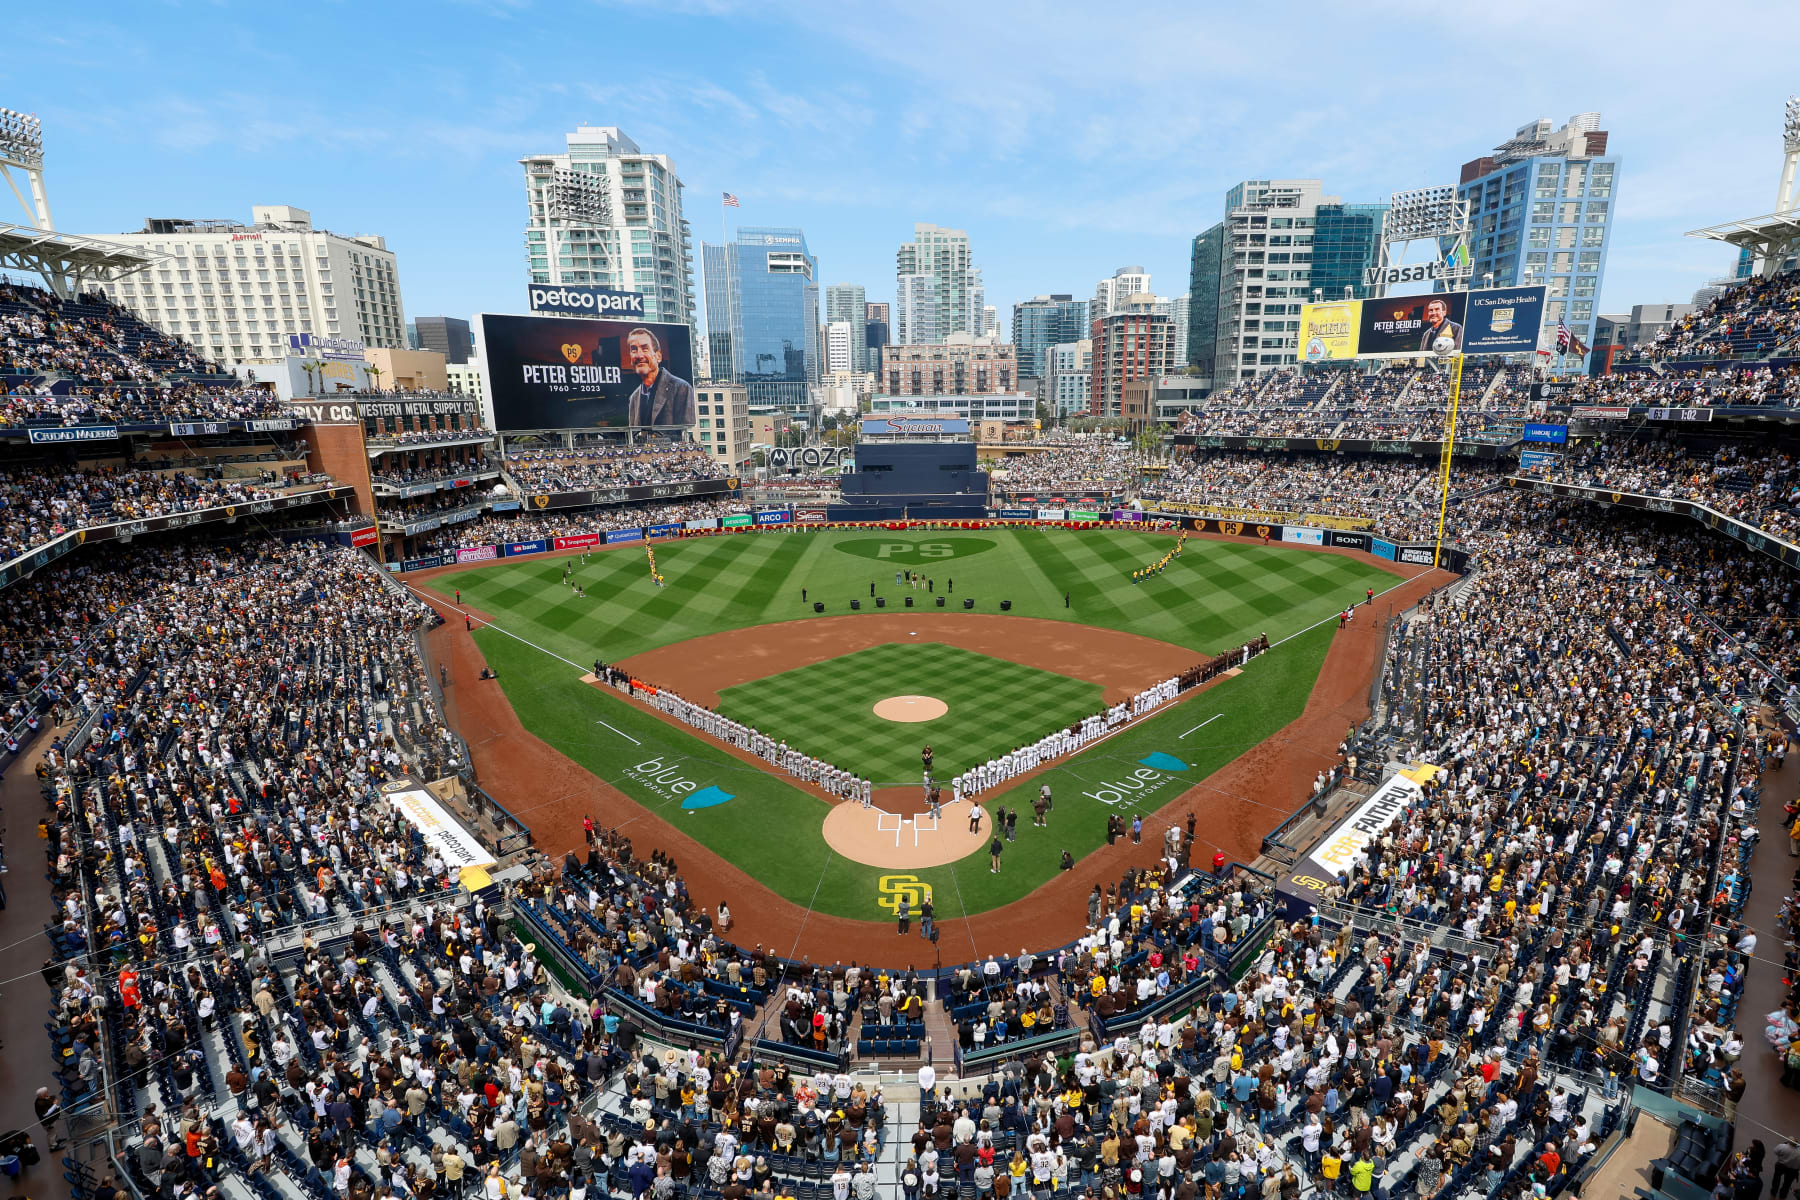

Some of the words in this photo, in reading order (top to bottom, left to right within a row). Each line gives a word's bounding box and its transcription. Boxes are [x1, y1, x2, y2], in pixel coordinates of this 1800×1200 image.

[1367, 262, 1436, 285] Viasat
[531, 287, 595, 310] petco
[597, 293, 643, 313] park
[1485, 298, 1496, 306] San
[1497, 297, 1515, 305] Diego
[1516, 295, 1537, 303] Health
[1374, 321, 1394, 330] PETER
[1395, 319, 1421, 329] SEIDLER
[567, 348, 577, 358] PS
[522, 364, 567, 383] PETER
[571, 366, 621, 383] SEIDLER
[330, 405, 358, 421] CO.
[358, 403, 401, 417] WESTERN
[405, 402, 432, 415] METAL
[434, 401, 461, 414] SUPPLY
[464, 401, 477, 413] CO.
[1681, 410, 1697, 420] 1:02
[203, 423, 218, 433] 1:02
[886, 416, 944, 437] Sycuan
[33, 431, 75, 441] CIUDAD
[76, 429, 118, 440] MADERAS
[1322, 439, 1334, 450] PS
[792, 447, 851, 466] razr
[759, 514, 781, 523] ARCO
[1225, 523, 1237, 535] PS
[567, 537, 597, 546] Snapdragon
[1336, 536, 1363, 545] SONY
[877, 543, 954, 558] PS
[1401, 553, 1434, 564] HOMERS
[633, 756, 697, 794] blue
[622, 768, 673, 800] CALIFORNIA
[1082, 768, 1161, 805] blue
[1118, 775, 1176, 810] CALIFORNIA
[401, 794, 441, 828] WELCOME
[1351, 785, 1415, 834] FAITHFUL
[434, 830, 462, 853] petco
[452, 846, 477, 865] park
[1321, 835, 1363, 865] FOR
